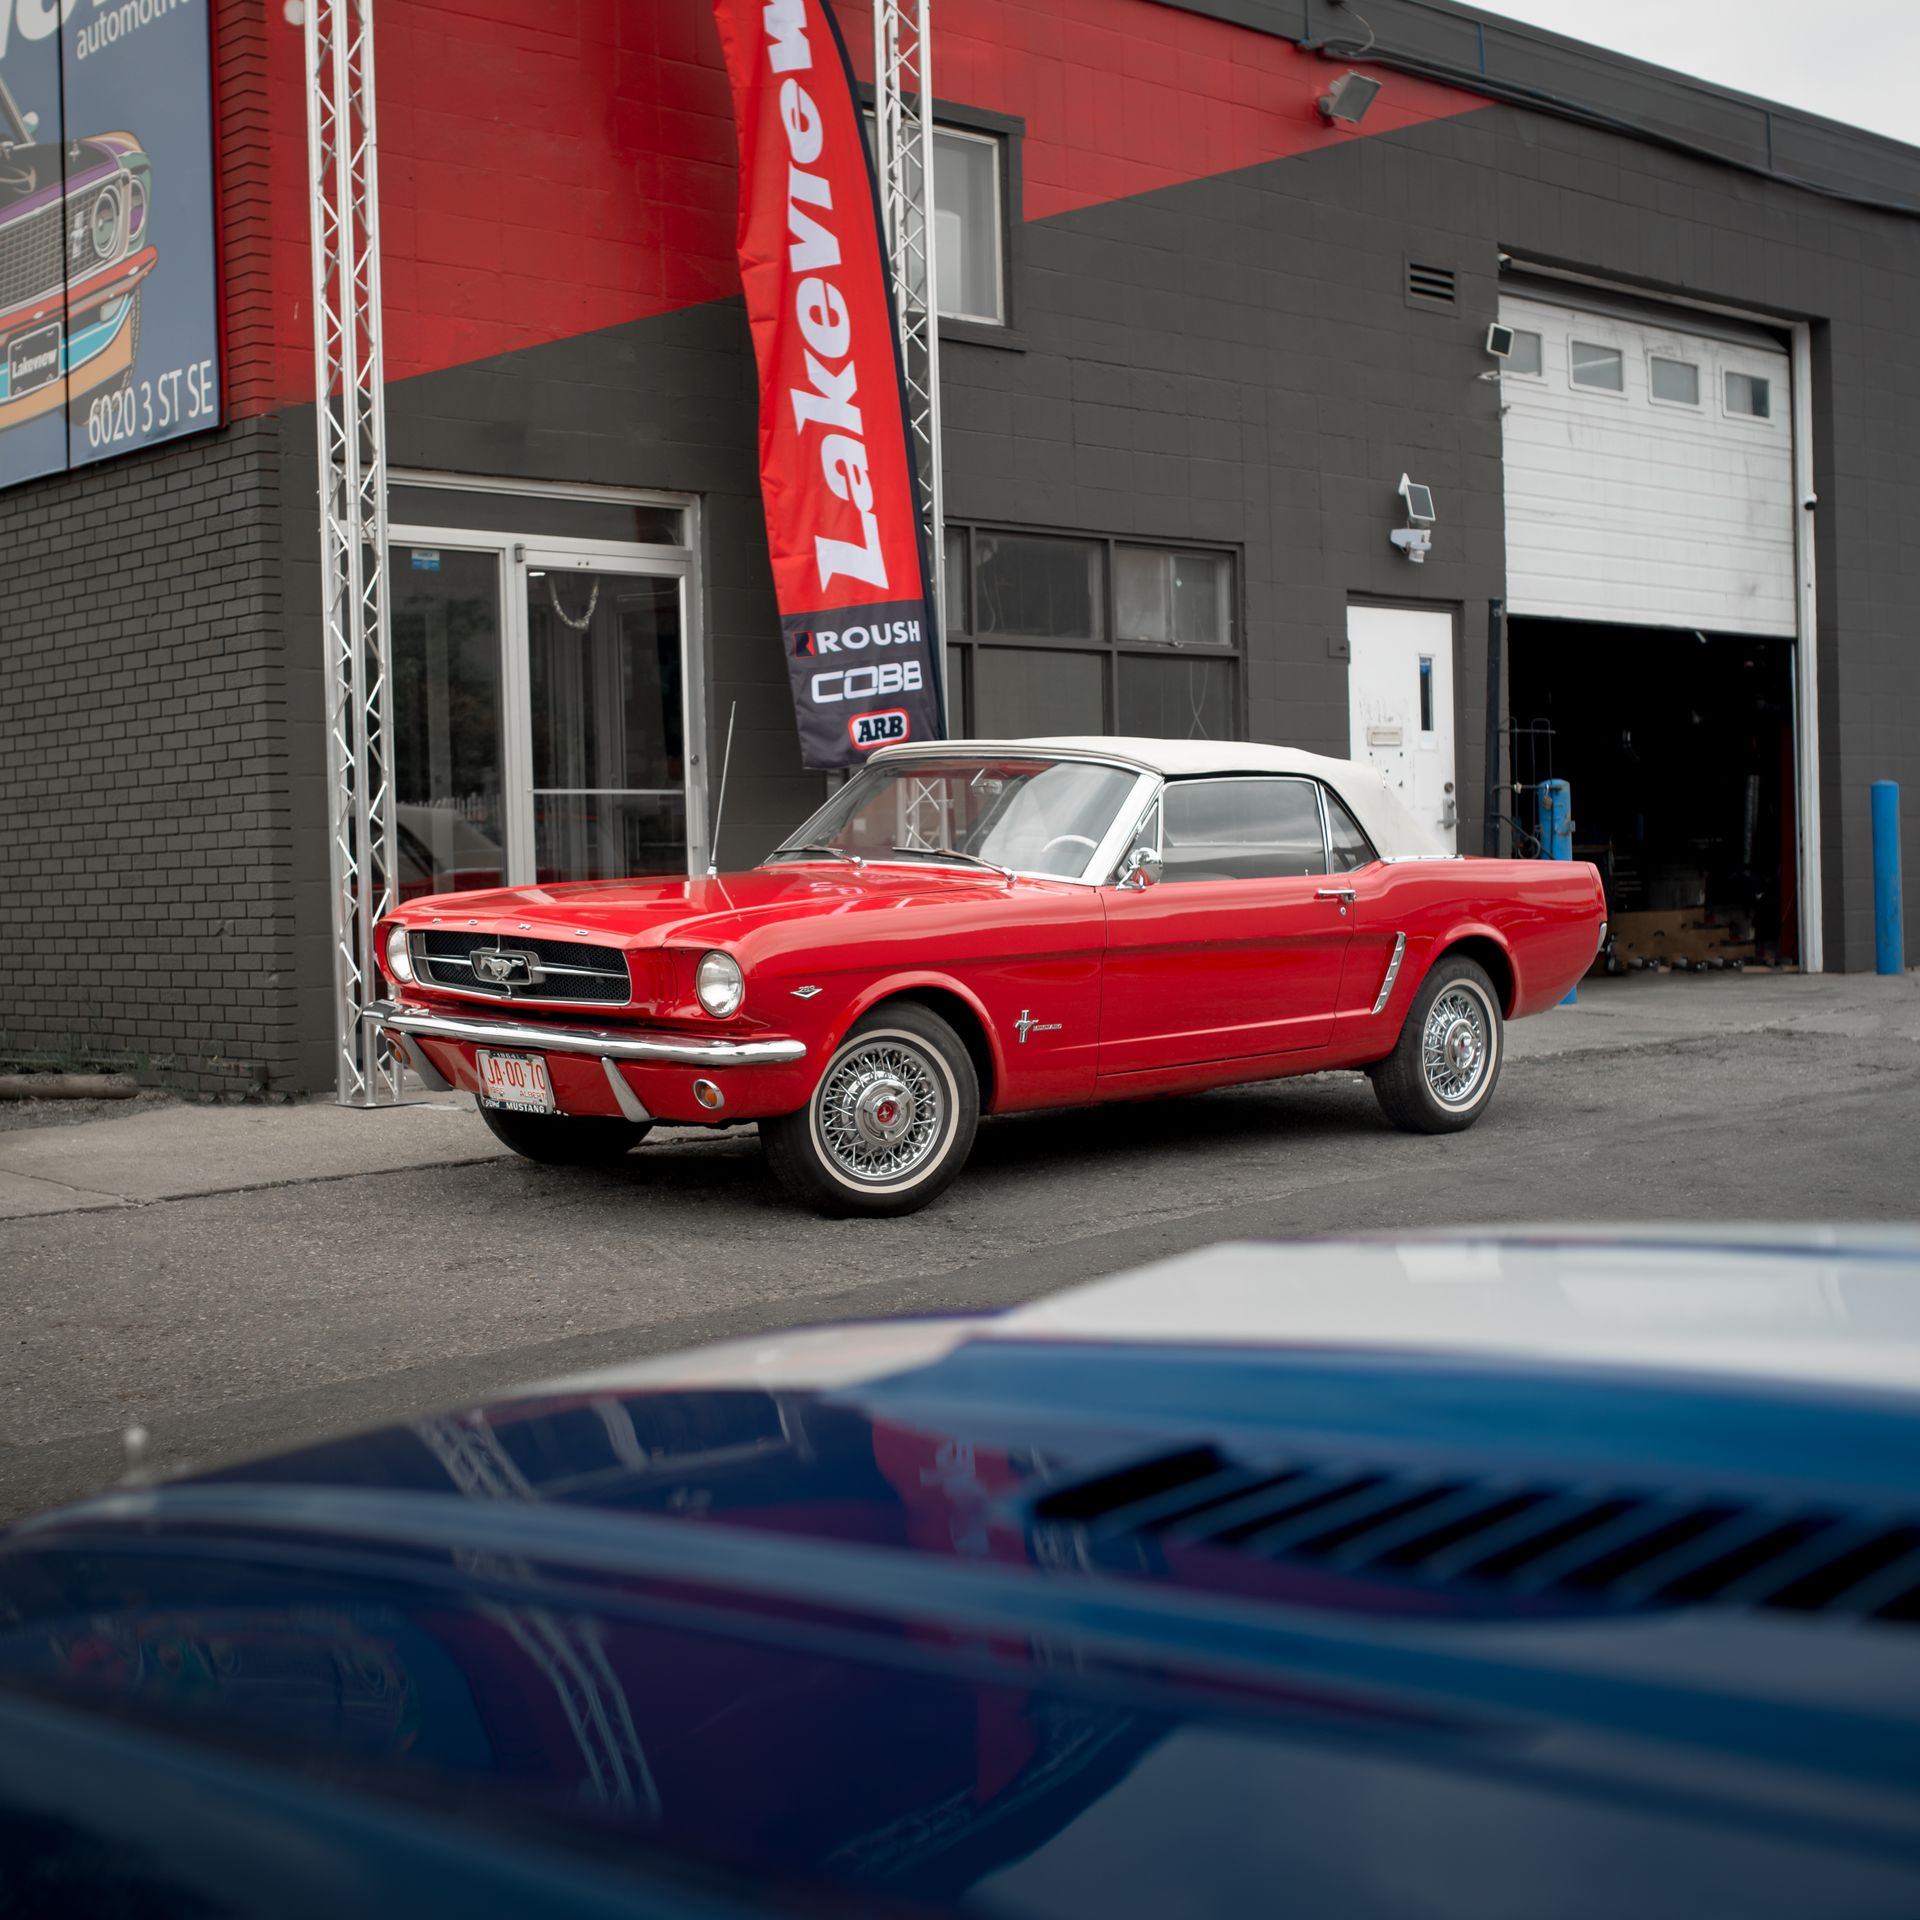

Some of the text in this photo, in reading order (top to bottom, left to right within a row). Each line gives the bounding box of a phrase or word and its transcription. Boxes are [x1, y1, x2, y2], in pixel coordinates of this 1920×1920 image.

[76, 0, 190, 60] automot
[763, 0, 889, 593] Lakeview
[88, 360, 214, 448] 6020 3 ST SE
[816, 620, 921, 654] ROUSH
[811, 660, 923, 704] COBB
[858, 715, 904, 743] ARB
[432, 918, 588, 936] FORD
[506, 1101, 545, 1113] MUSTANG
